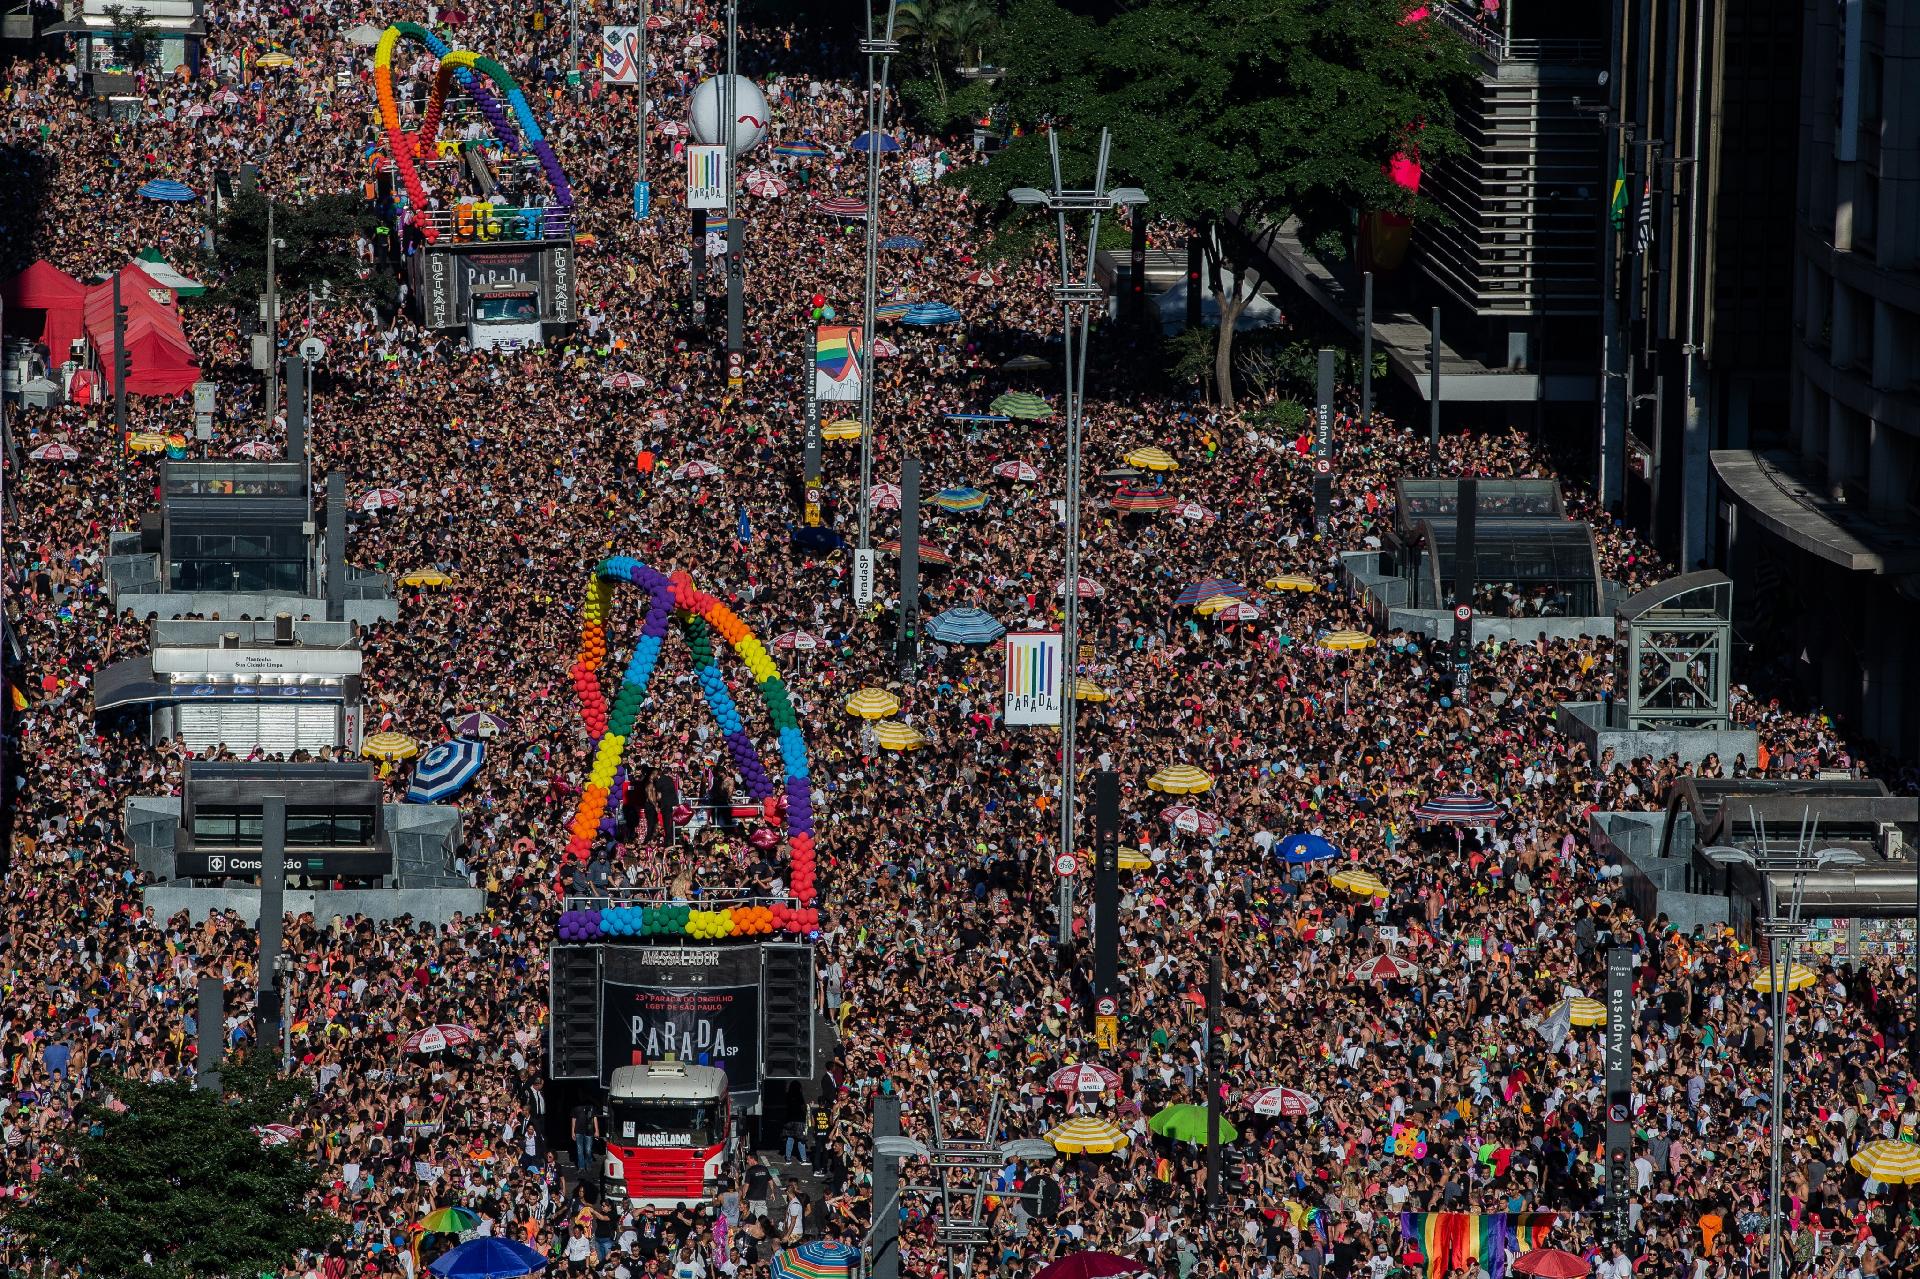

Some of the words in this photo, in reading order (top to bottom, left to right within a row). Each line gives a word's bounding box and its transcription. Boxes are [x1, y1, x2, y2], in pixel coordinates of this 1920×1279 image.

[688, 186, 720, 200] PARADA
[468, 268, 526, 286] PARDA
[807, 358, 815, 394] Manuel
[808, 396, 816, 420] João
[808, 424, 816, 436] Pe.
[1319, 404, 1328, 444] Augusta
[808, 440, 816, 448] R.
[1318, 448, 1326, 456] R.
[1008, 692, 1052, 712] PARADA
[642, 950, 720, 966] AVASSALADOR
[680, 1003, 695, 1011] SÃO
[1611, 989, 1626, 1054] Augusta
[631, 1015, 726, 1061] PARADA
[726, 1046, 738, 1056] SP
[637, 1134, 691, 1146] AVASSALADOR
